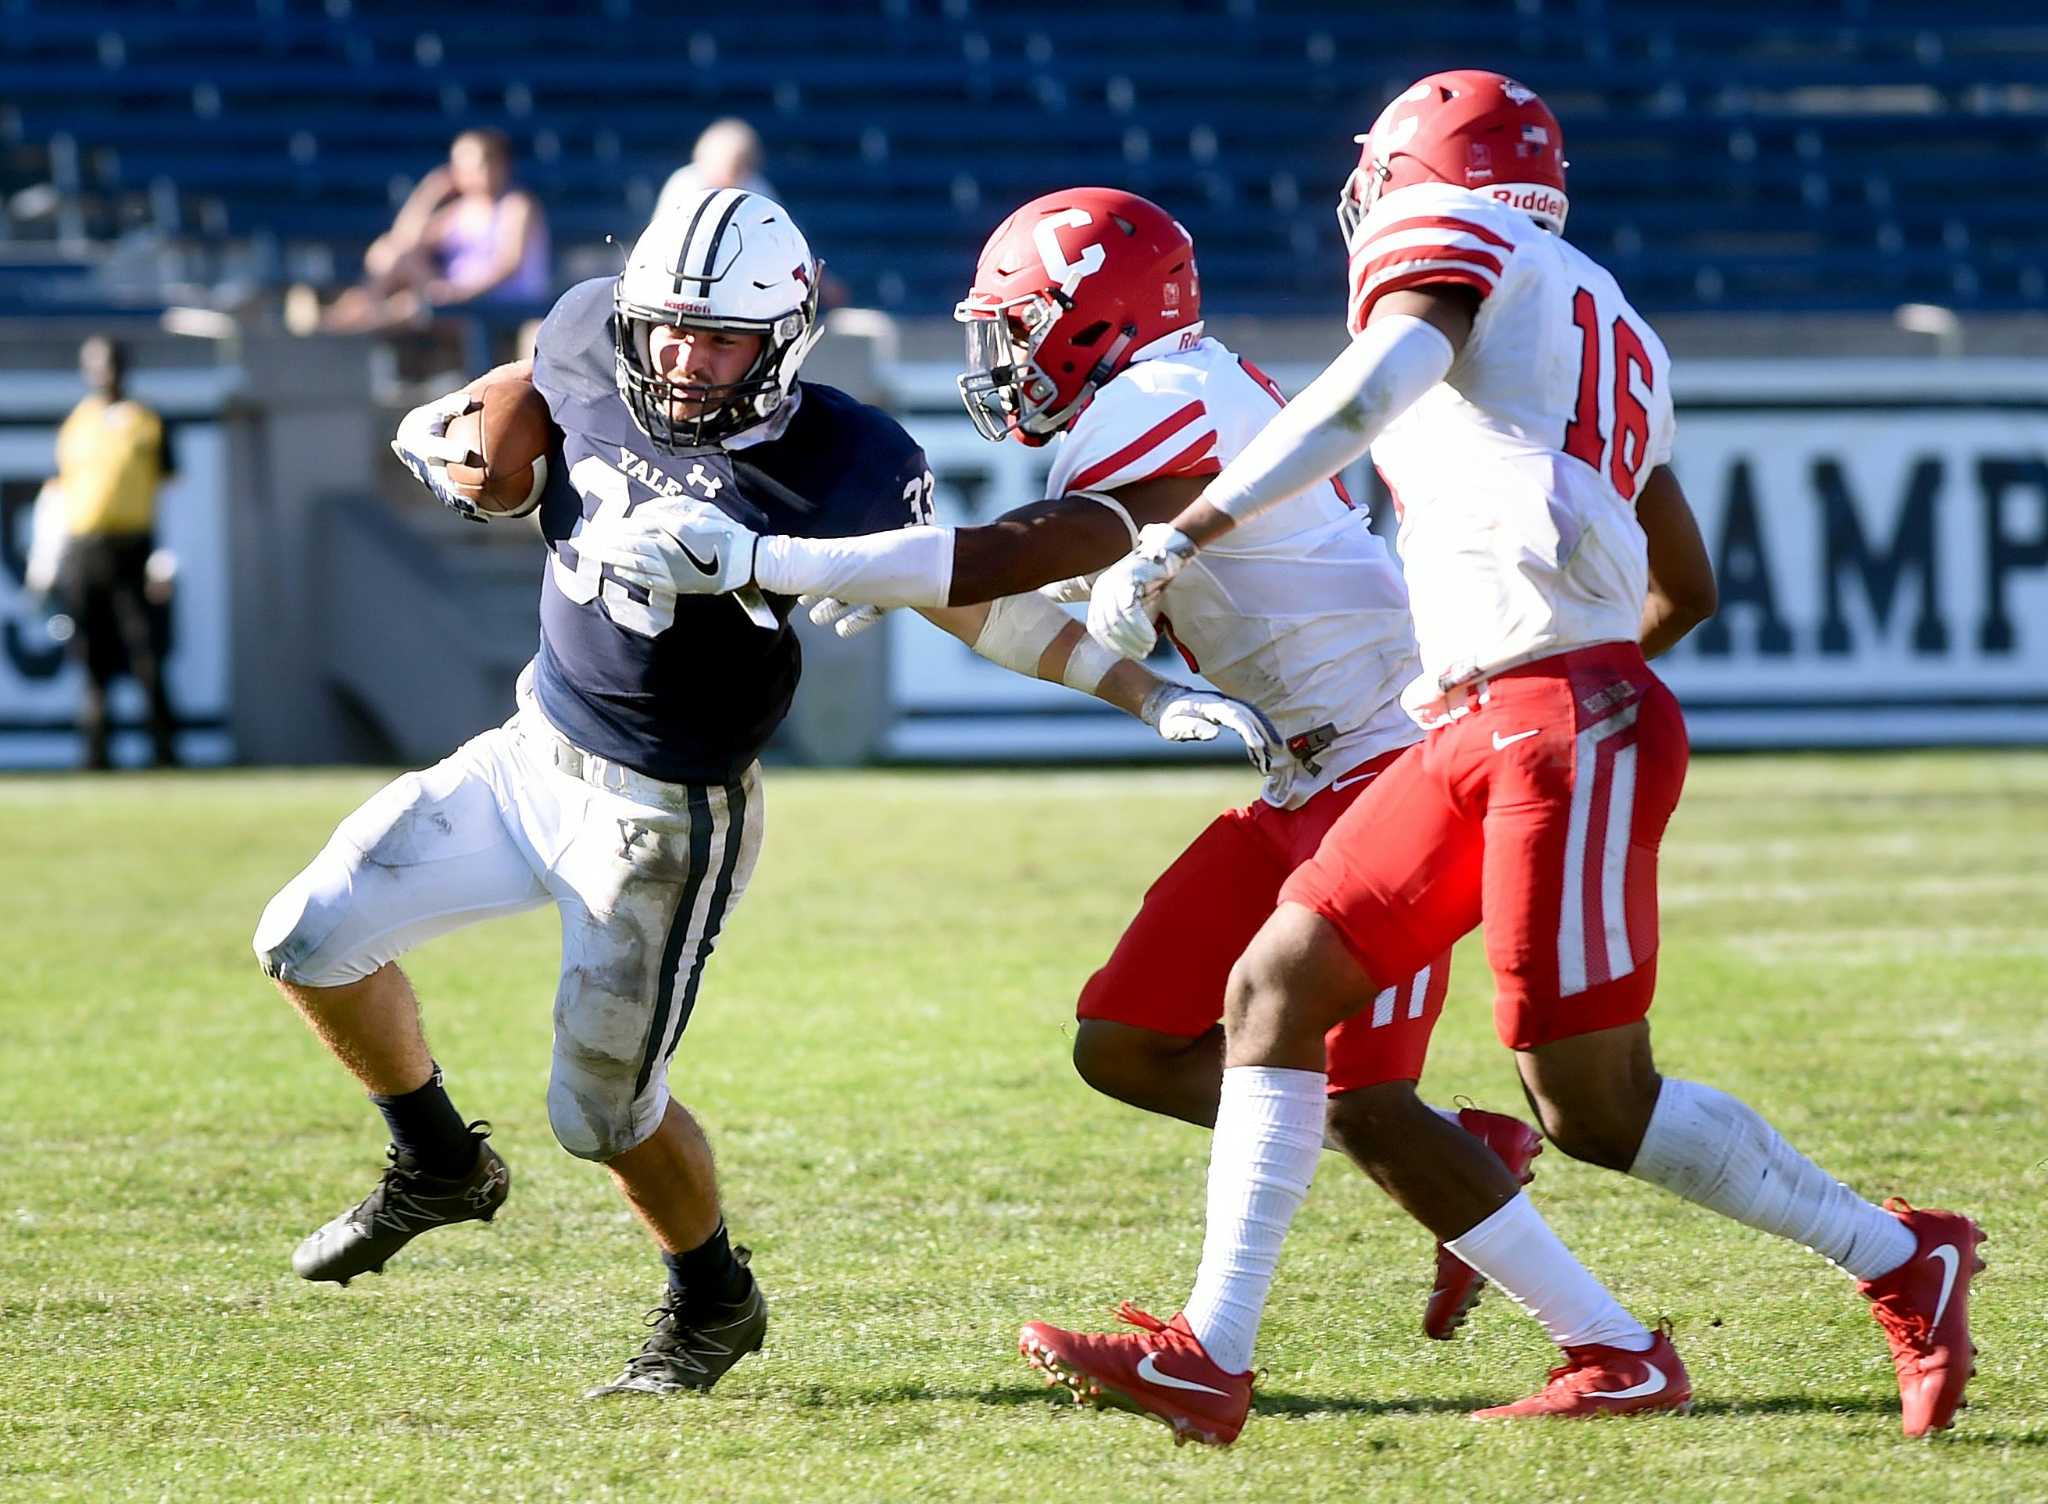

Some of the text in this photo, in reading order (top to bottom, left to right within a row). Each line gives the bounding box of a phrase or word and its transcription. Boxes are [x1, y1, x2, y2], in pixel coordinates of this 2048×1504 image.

[1032, 208, 1106, 285] C
[1562, 286, 1653, 501] 16
[617, 446, 684, 497] YALE
[902, 469, 937, 527] 33
[616, 818, 649, 861] Y
